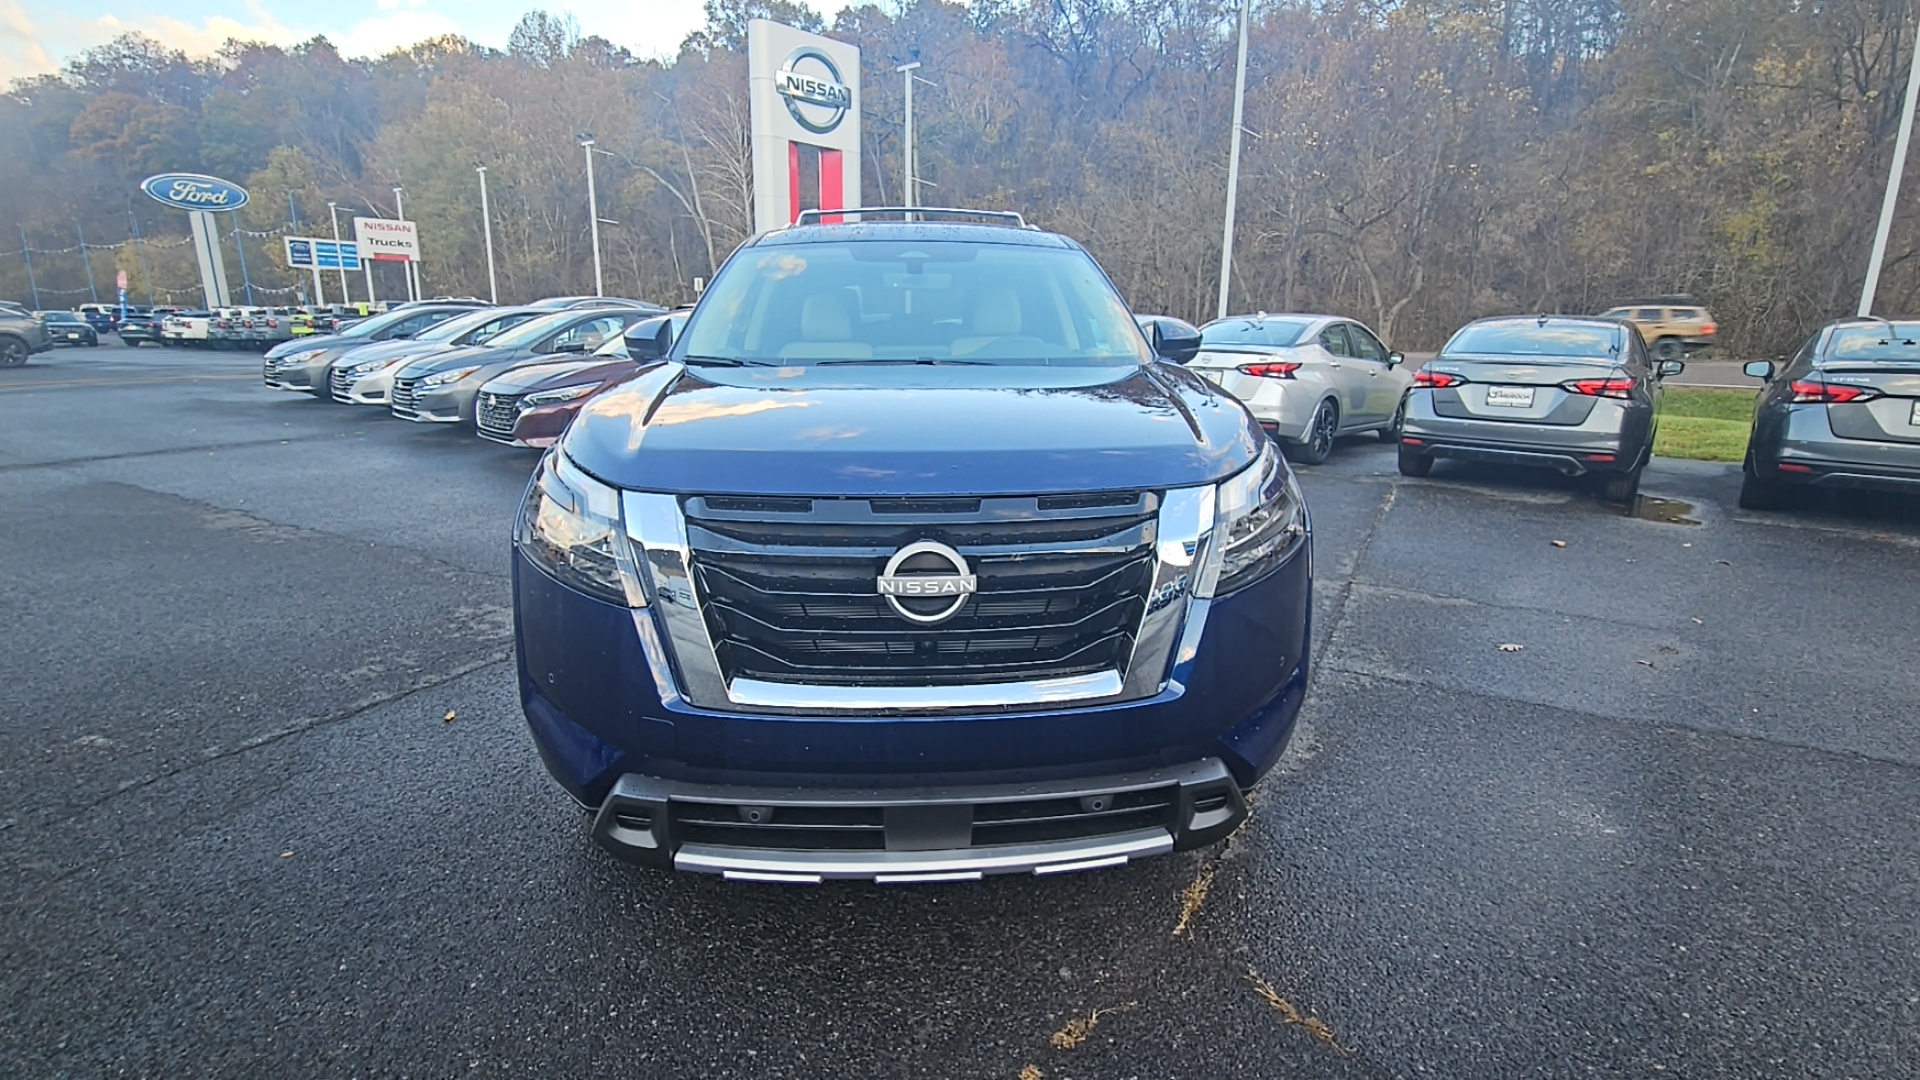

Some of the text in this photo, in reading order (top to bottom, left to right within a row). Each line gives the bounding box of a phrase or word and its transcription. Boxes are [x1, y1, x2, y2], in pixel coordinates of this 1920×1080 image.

[786, 75, 847, 102] NISSAN
[169, 180, 228, 204] Ford
[364, 222, 411, 232] NISSAN
[367, 237, 412, 248] Trucks
[880, 579, 974, 593] NISSAN
